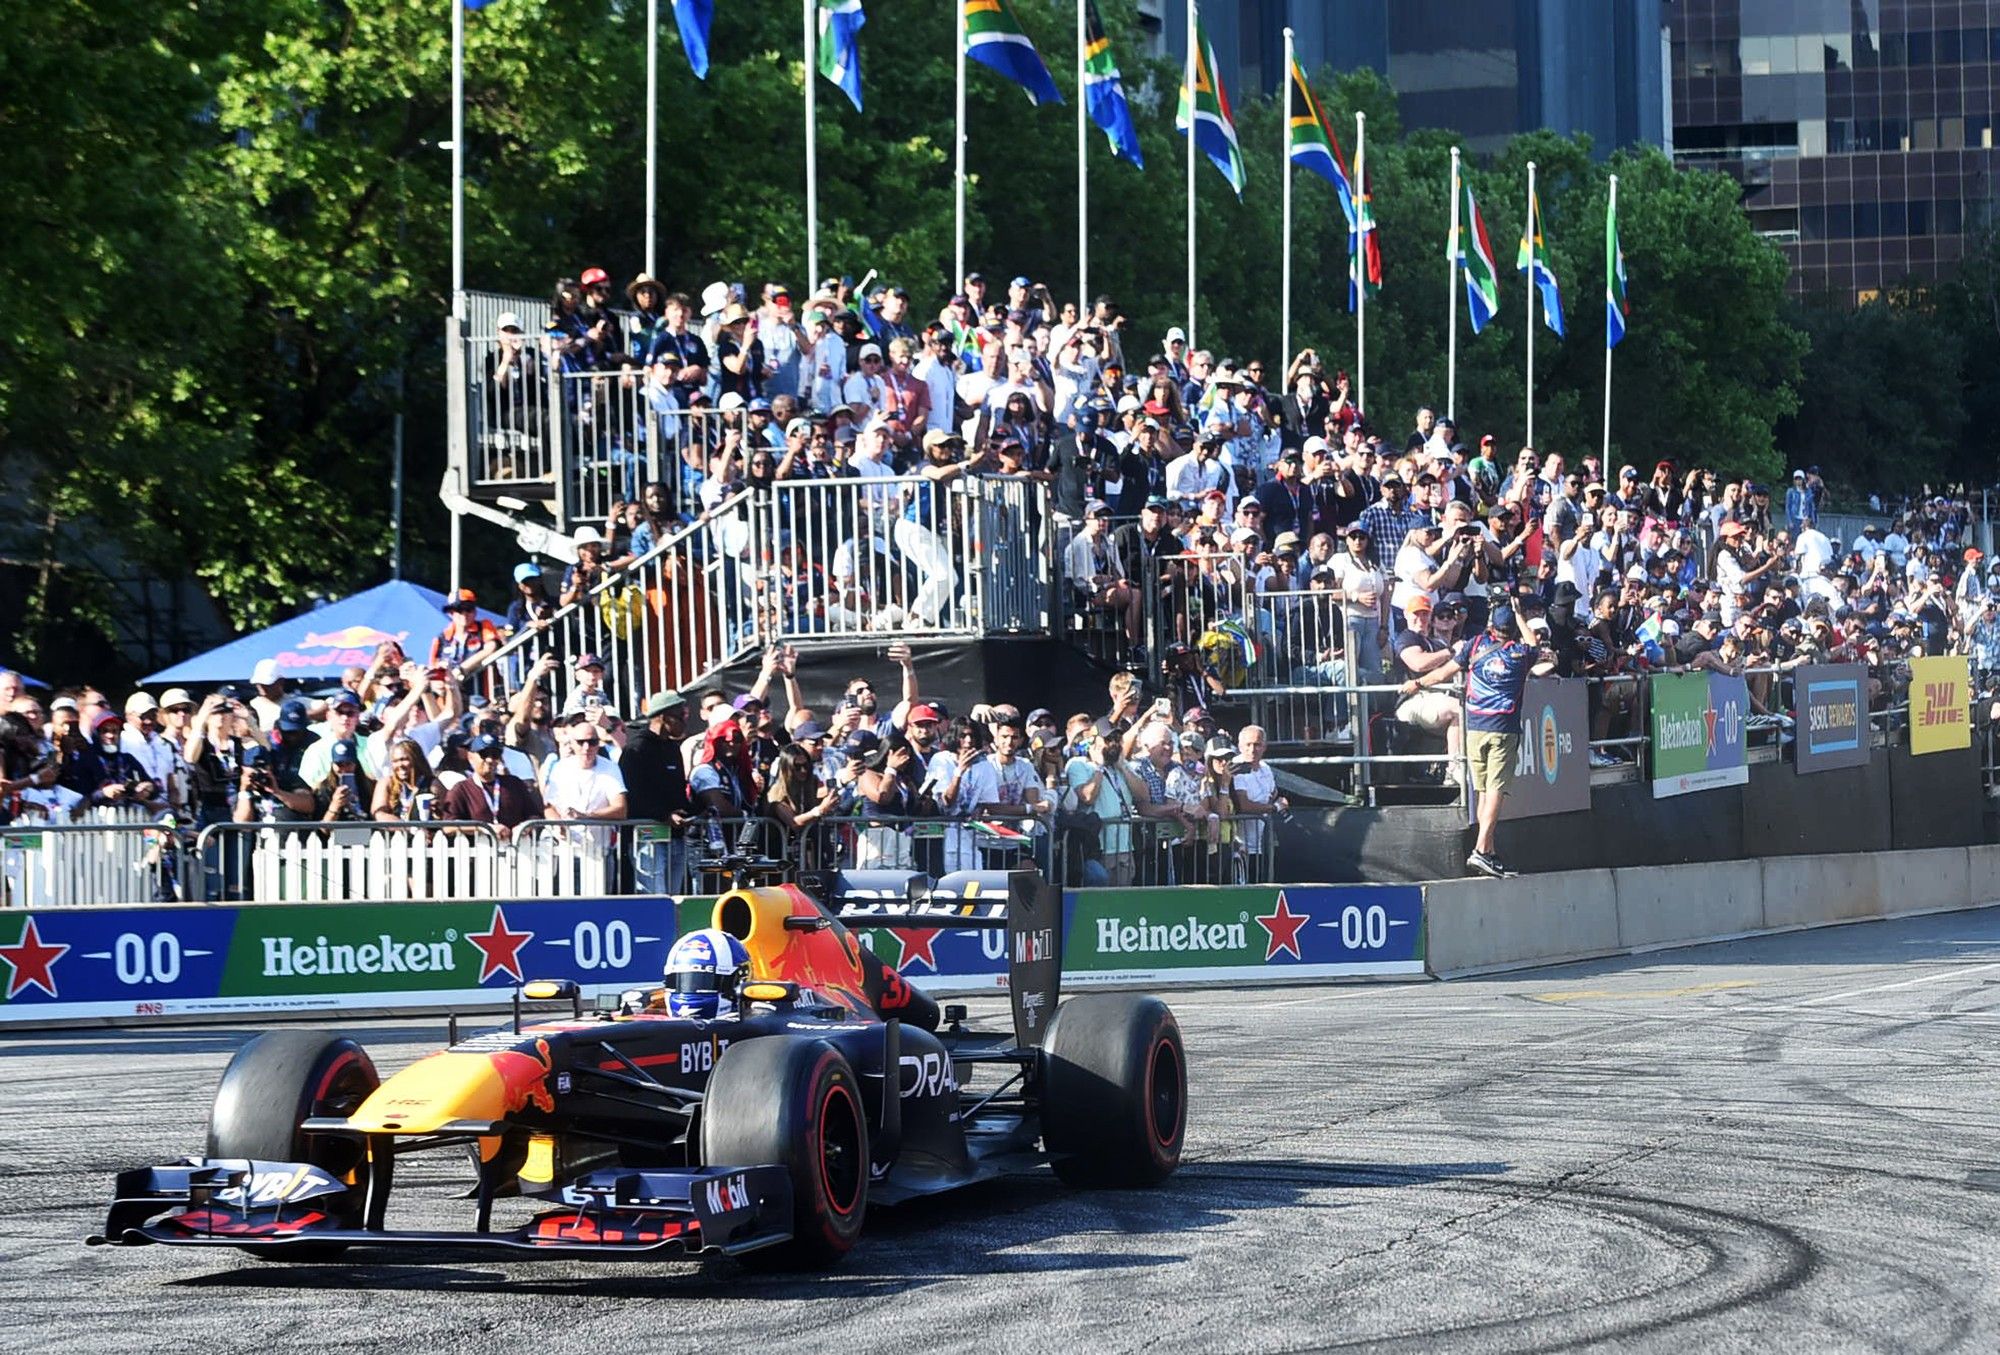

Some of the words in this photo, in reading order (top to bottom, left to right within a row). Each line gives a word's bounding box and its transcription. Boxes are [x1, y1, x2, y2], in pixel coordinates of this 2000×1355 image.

[275, 650, 340, 668] Red
[1659, 711, 1703, 750] Heineken
[575, 920, 632, 969] 0.0
[1096, 916, 1248, 953] Heineken
[1341, 905, 1387, 950] 0.0
[115, 931, 181, 985] 0.0
[261, 934, 456, 976] Heineken
[705, 1173, 750, 1215] Mobil
